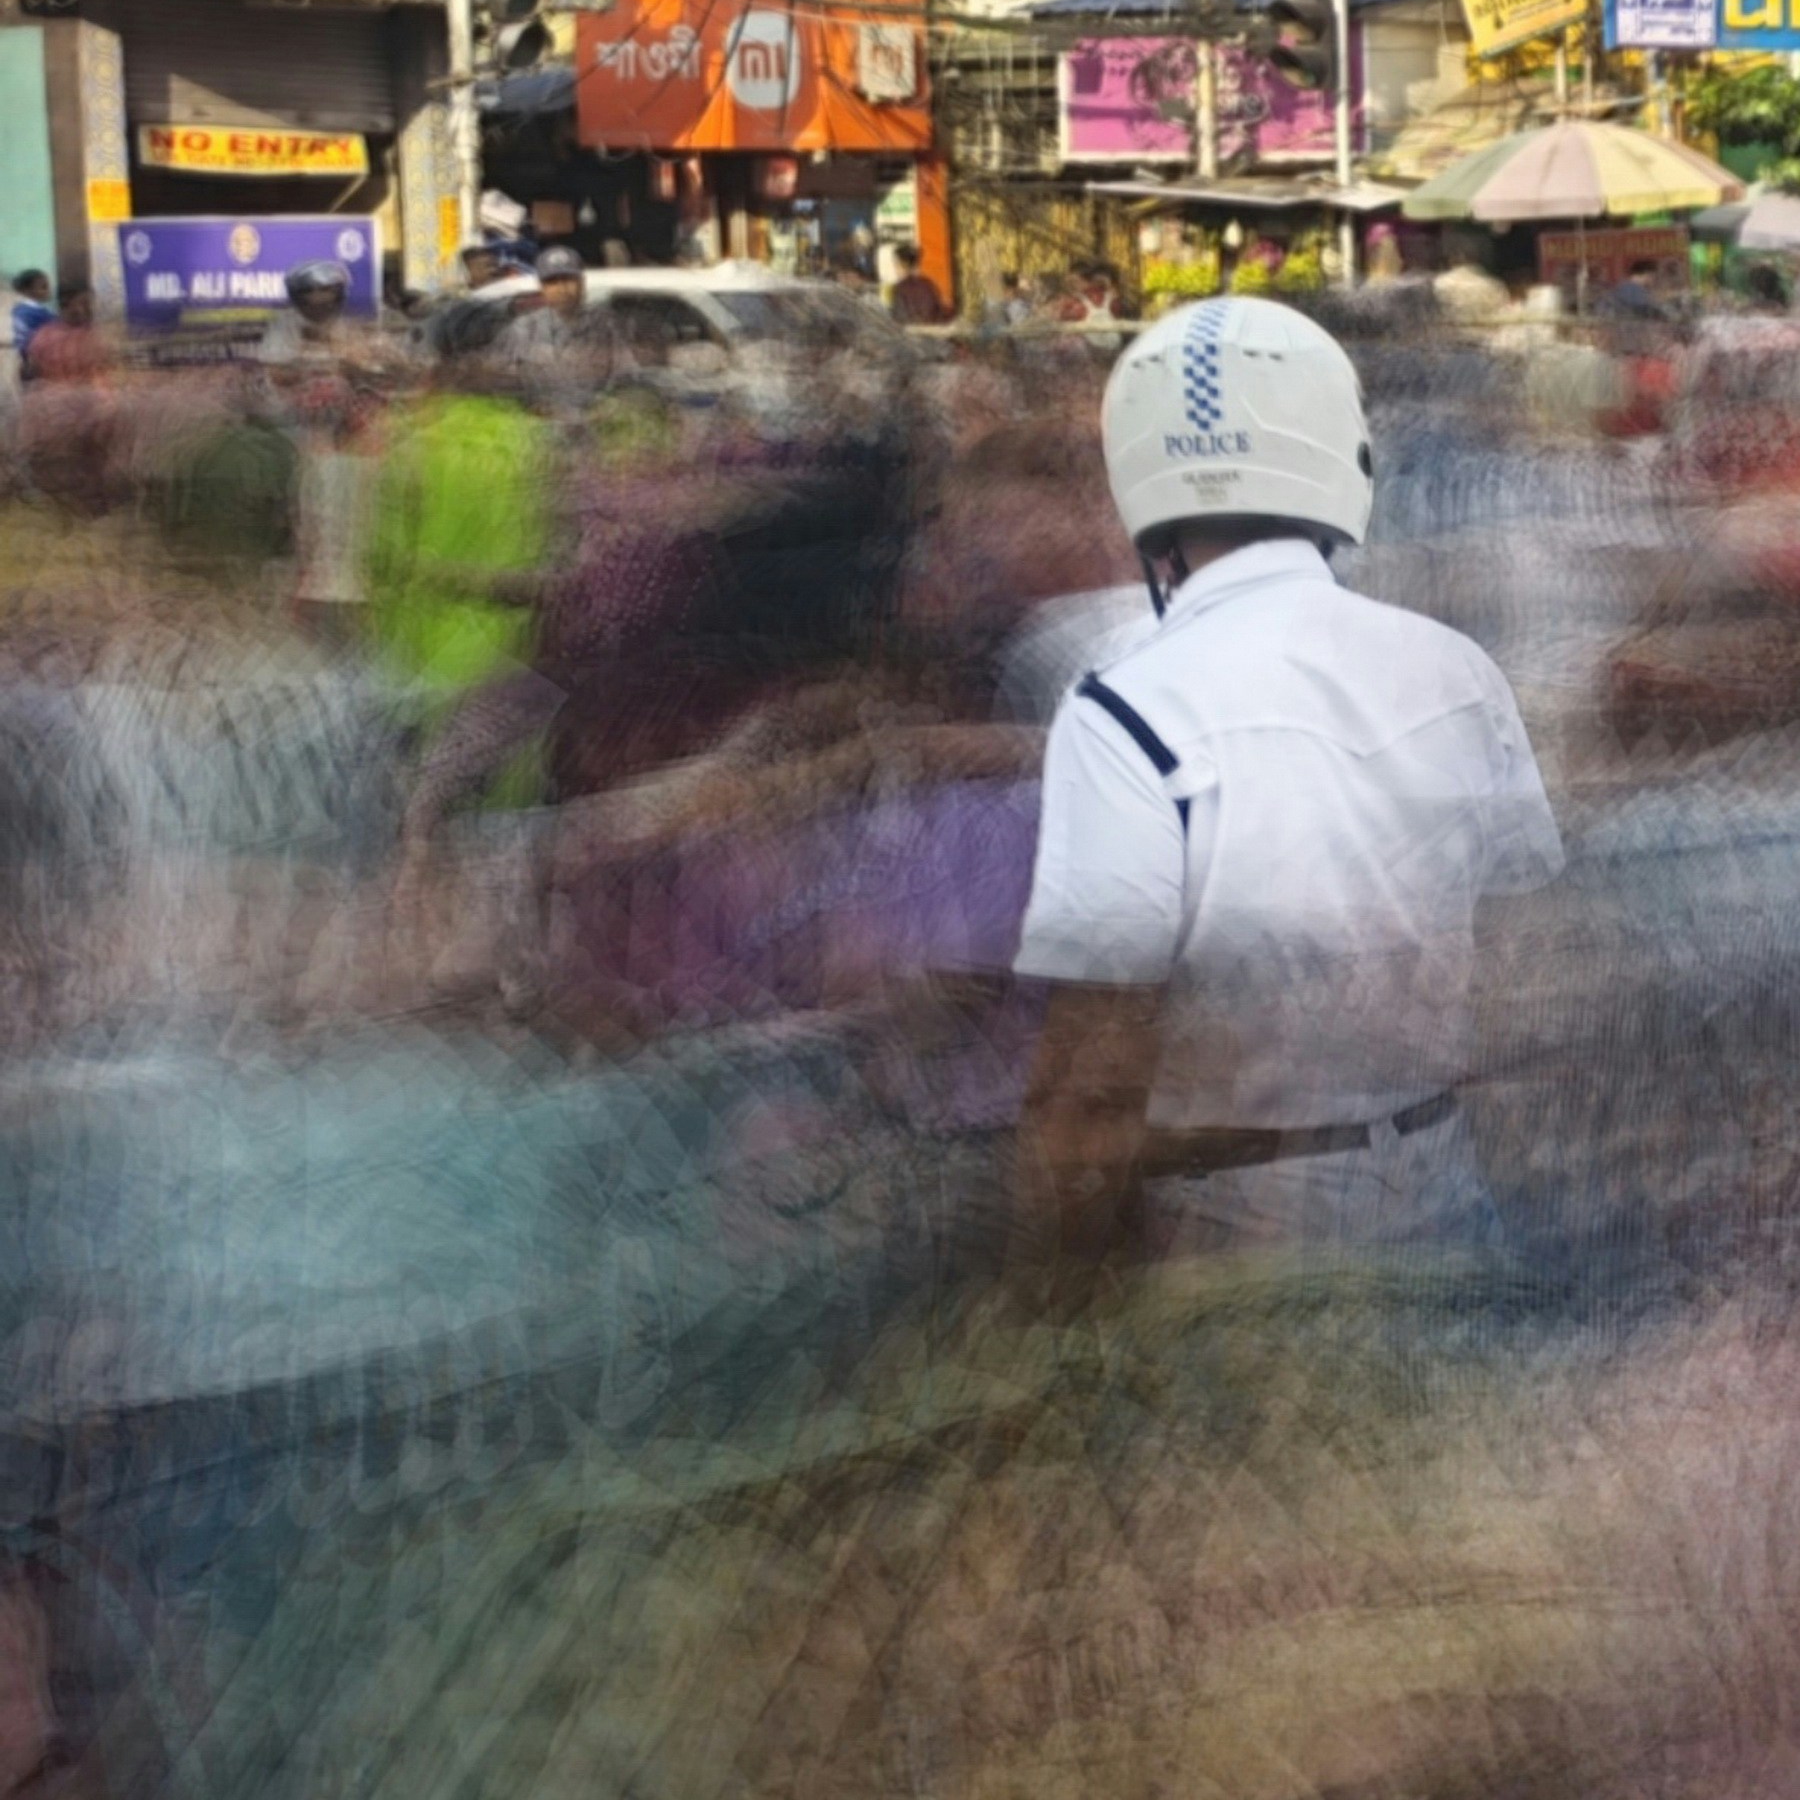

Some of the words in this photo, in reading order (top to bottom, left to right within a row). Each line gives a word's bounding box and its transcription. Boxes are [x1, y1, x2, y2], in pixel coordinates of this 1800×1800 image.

[149, 129, 212, 151] NO
[228, 135, 350, 155] ENTRY
[1164, 430, 1251, 457] POLICE
